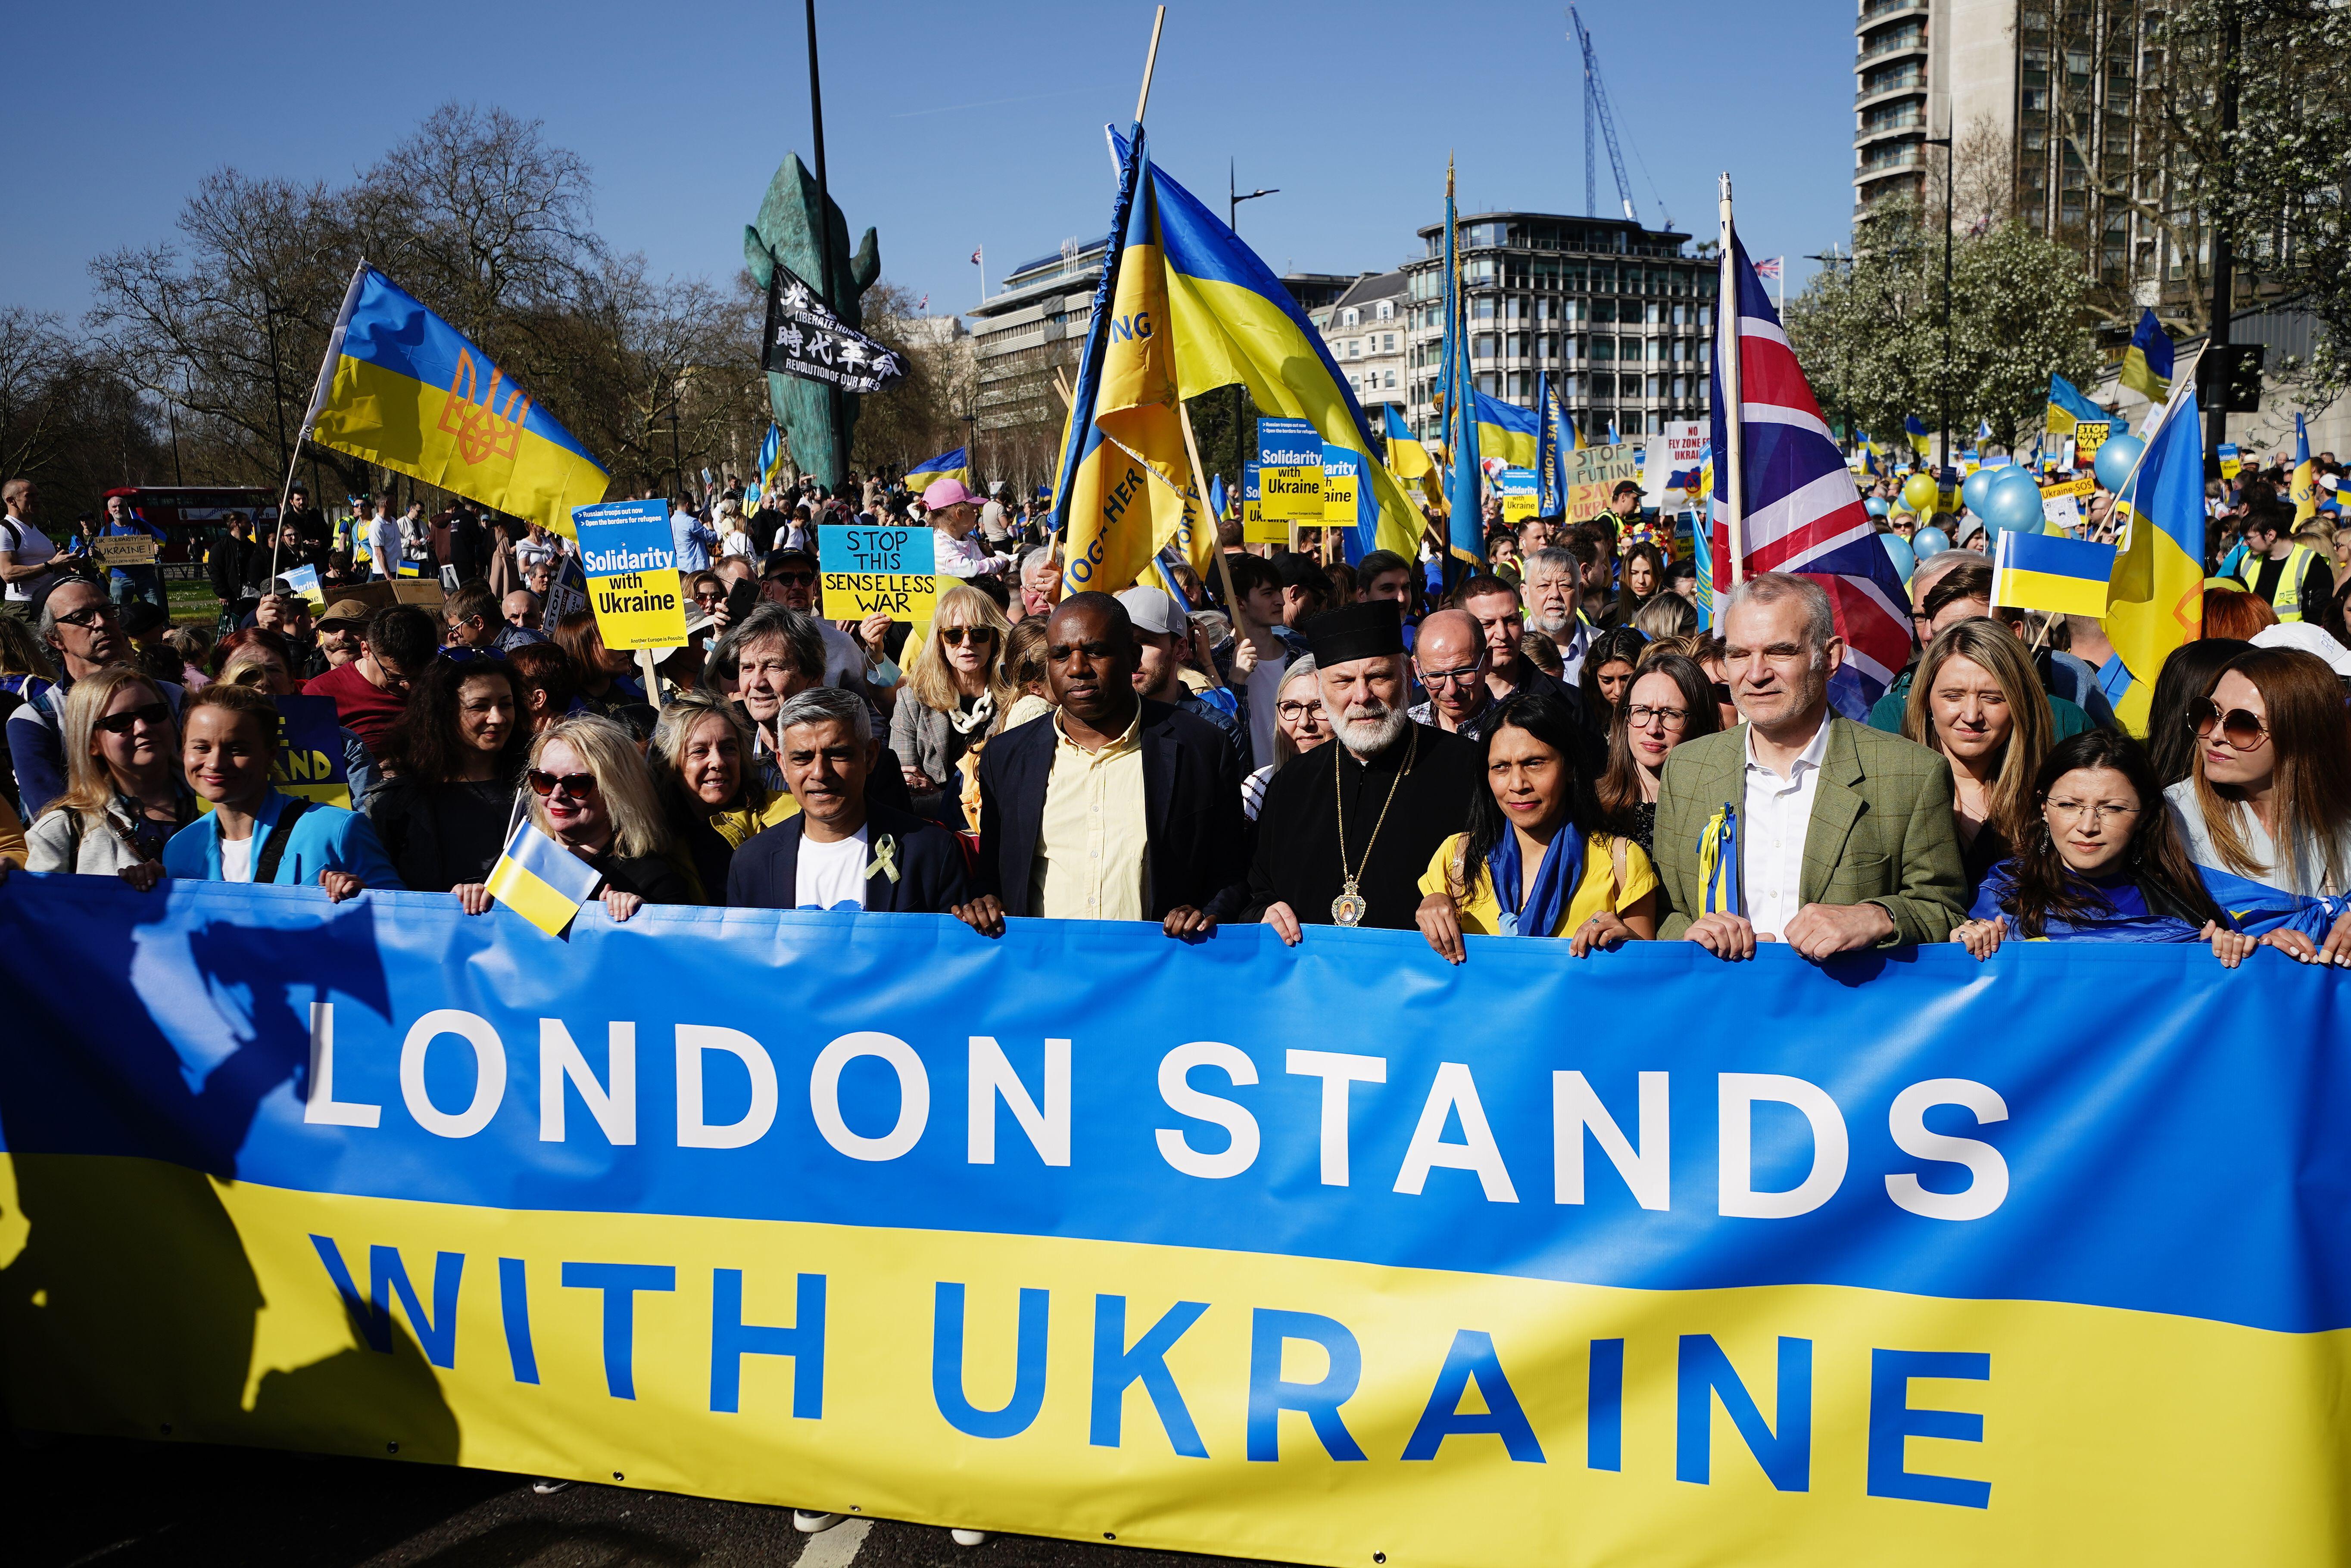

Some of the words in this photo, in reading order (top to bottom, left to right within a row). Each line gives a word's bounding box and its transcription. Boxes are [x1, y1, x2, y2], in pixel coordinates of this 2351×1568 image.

[795, 310, 835, 330] LIBERATE
[1111, 311, 1153, 344] NG
[776, 322, 902, 381] 時代革命
[786, 358, 829, 380] REVOLUTION
[829, 370, 840, 383] OF
[840, 373, 858, 388] OUR
[1548, 387, 1560, 421] НАМ
[1547, 423, 1558, 441] ЗА
[1688, 426, 1698, 436] NO
[2077, 424, 2109, 434] STOP
[1669, 439, 1680, 449] FLY
[1682, 438, 1700, 448] ZONE
[1262, 449, 1322, 467] Solidarity
[1576, 444, 1627, 467] STOP
[1674, 450, 1700, 460] UKRAI
[1278, 467, 1300, 478] with
[1323, 460, 1357, 477] arity
[1577, 463, 1634, 483] PUTIN!
[1268, 479, 1319, 494] Ukraine
[1324, 488, 1351, 502] aine
[1504, 486, 1537, 495] Solidarity
[1579, 480, 1616, 501] SAV
[2042, 481, 2092, 499] Ukraine-SOS
[1062, 467, 1144, 594] TOGHER
[1176, 501, 1197, 554] TORY
[846, 531, 908, 551] STOP
[584, 547, 674, 572] Solidarity
[853, 552, 901, 570] THIS
[293, 580, 318, 593] darity
[609, 572, 642, 590] with
[826, 573, 935, 594] SENSELESS
[548, 588, 560, 628] STOP
[599, 589, 675, 614] Ukraine
[854, 593, 912, 613] WAR
[267, 750, 332, 781] AND
[303, 1002, 1071, 1167] LONDON
[1155, 1041, 2009, 1221] STANDS
[308, 1233, 826, 1420] WITH
[932, 1282, 1992, 1509] UKRAINE
